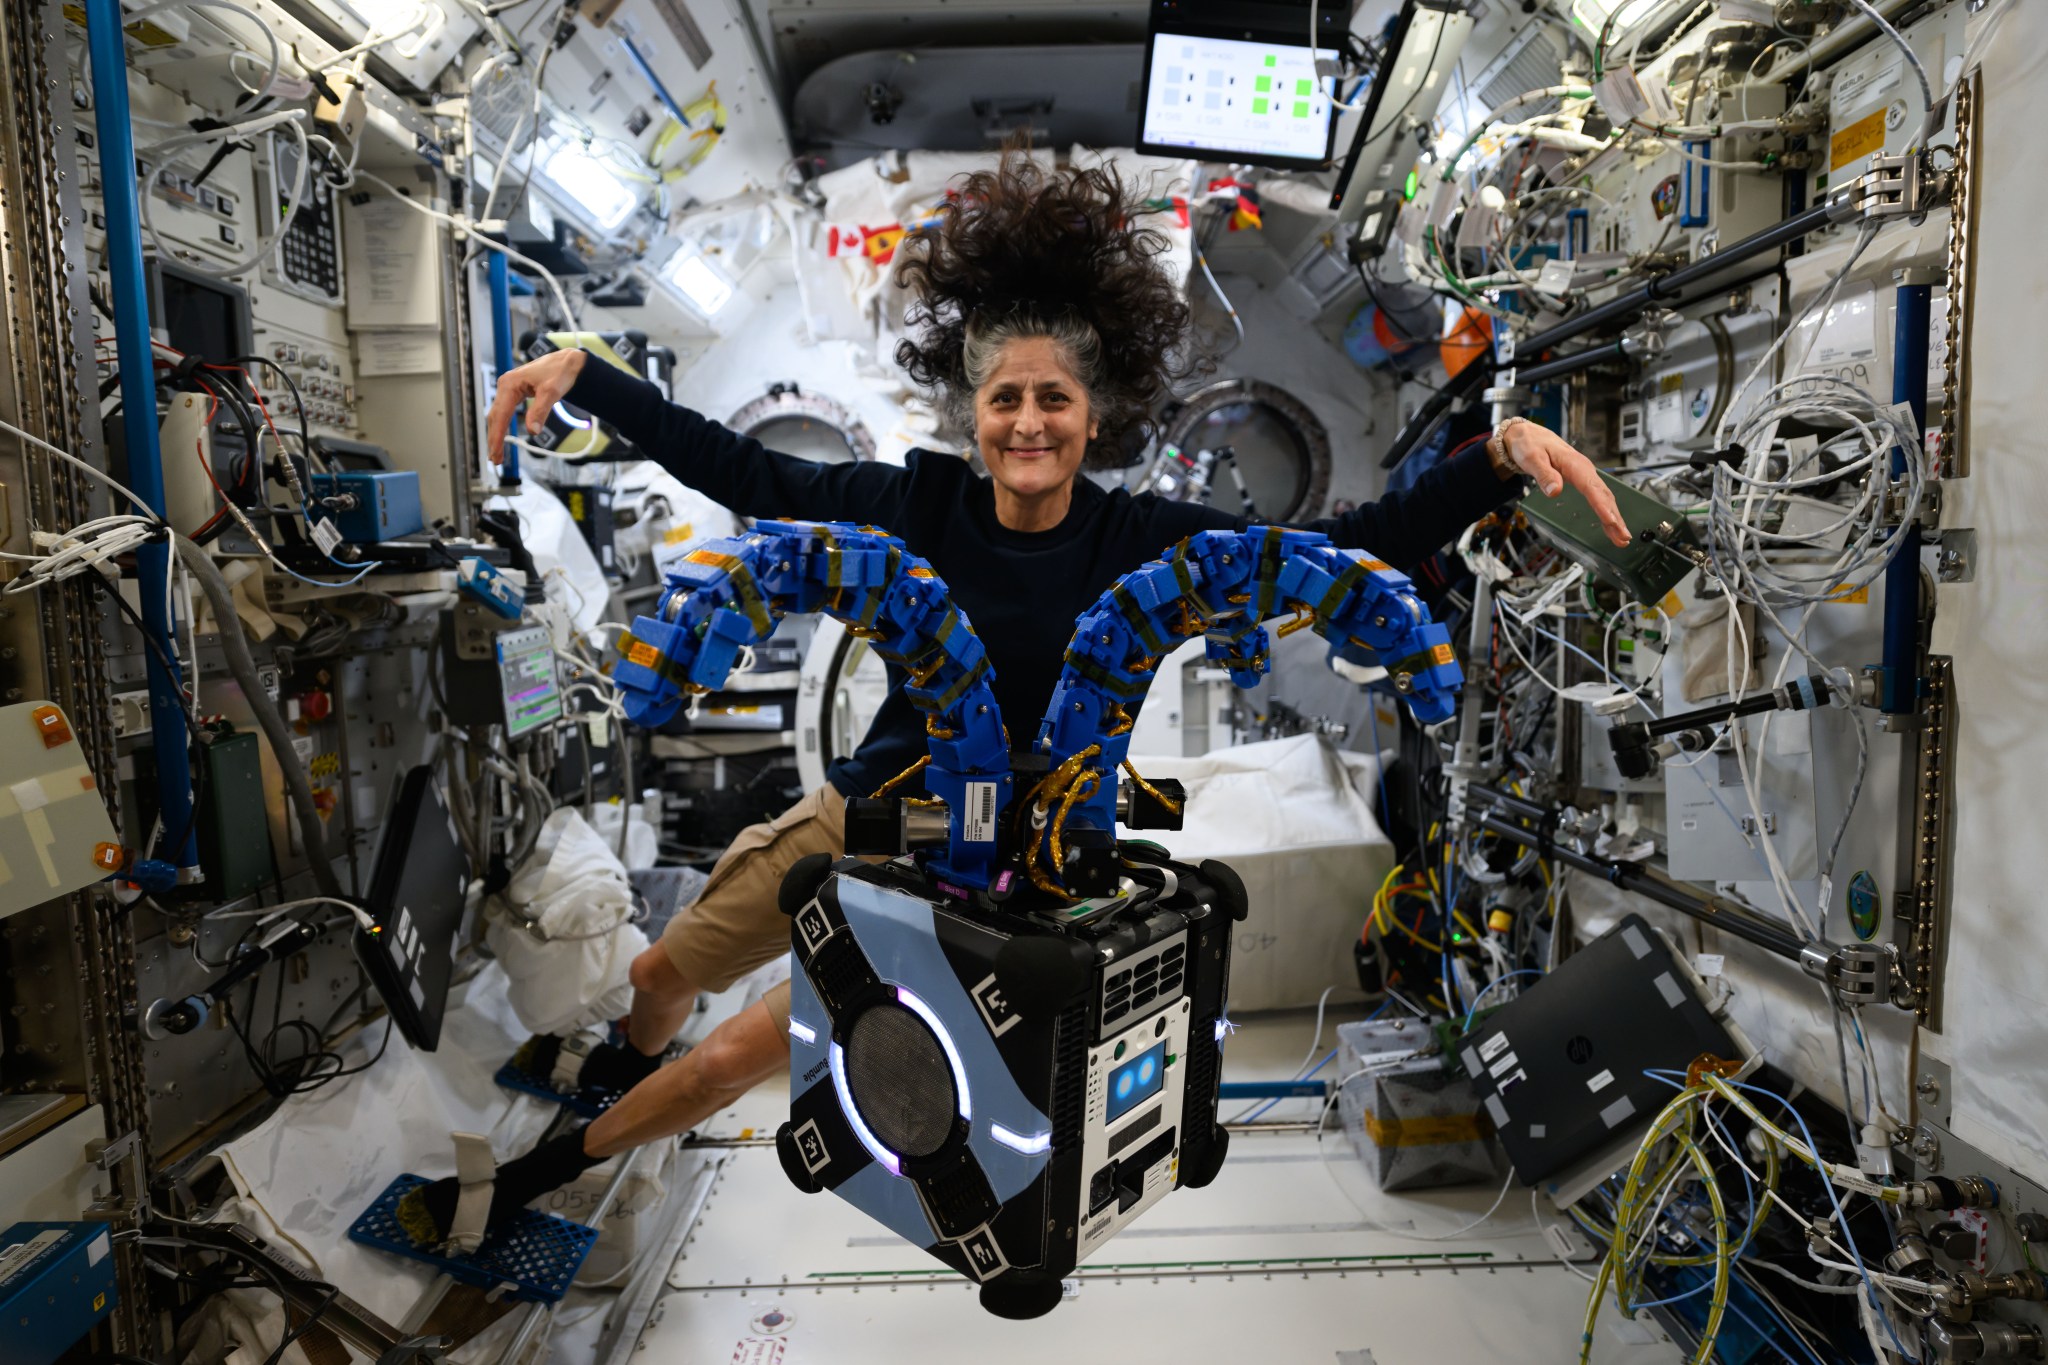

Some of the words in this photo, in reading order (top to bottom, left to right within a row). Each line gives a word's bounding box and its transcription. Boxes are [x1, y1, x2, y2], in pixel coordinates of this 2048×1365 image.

[1839, 72, 1864, 93] MERLIN
[1832, 120, 1884, 155] MERLIN-2
[1567, 1036, 1594, 1063] hp
[802, 1057, 831, 1083] Bumble
